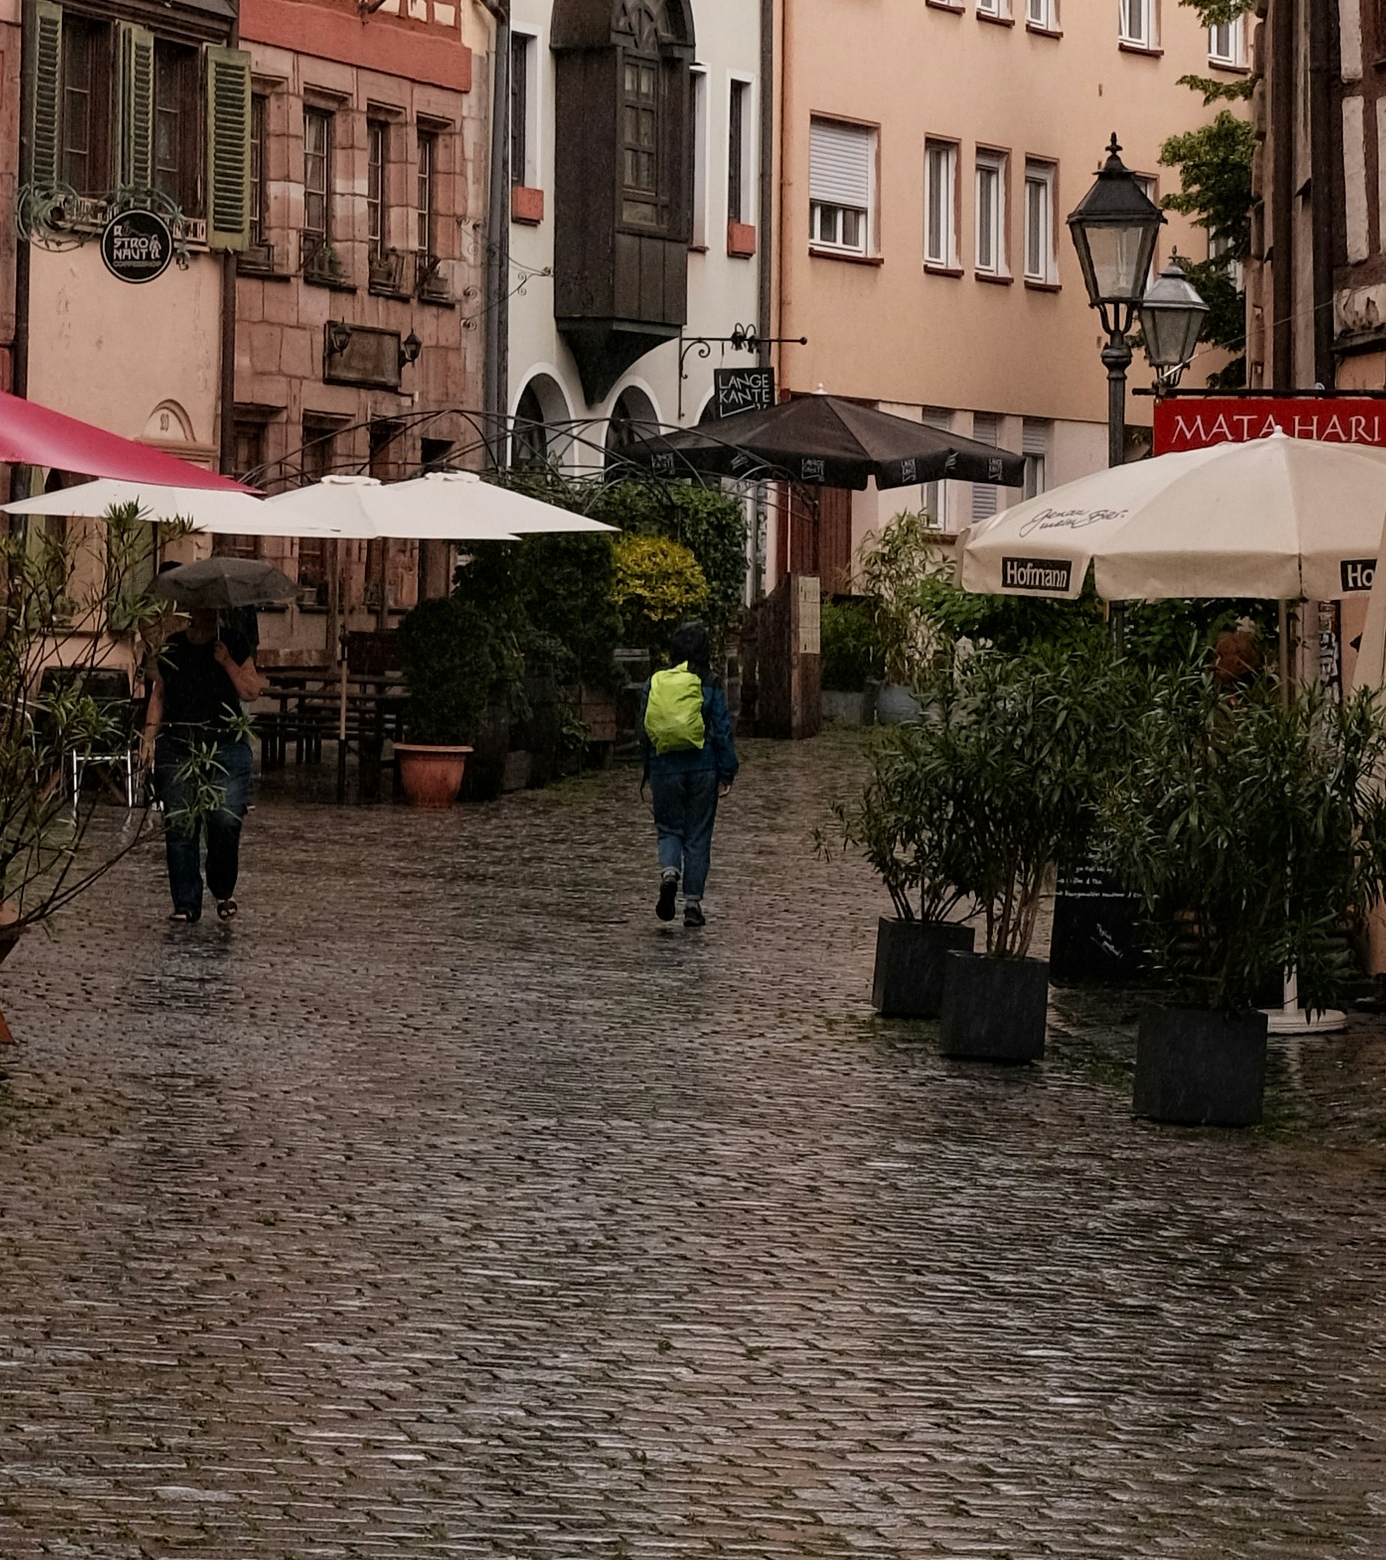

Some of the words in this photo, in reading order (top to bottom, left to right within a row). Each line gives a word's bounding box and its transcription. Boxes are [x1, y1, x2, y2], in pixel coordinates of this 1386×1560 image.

[718, 373, 769, 389] LANGE
[719, 388, 771, 405] KANTE
[1172, 413, 1277, 444] MATA
[1293, 414, 1382, 443] HARI
[1006, 560, 1068, 588] Hofmann
